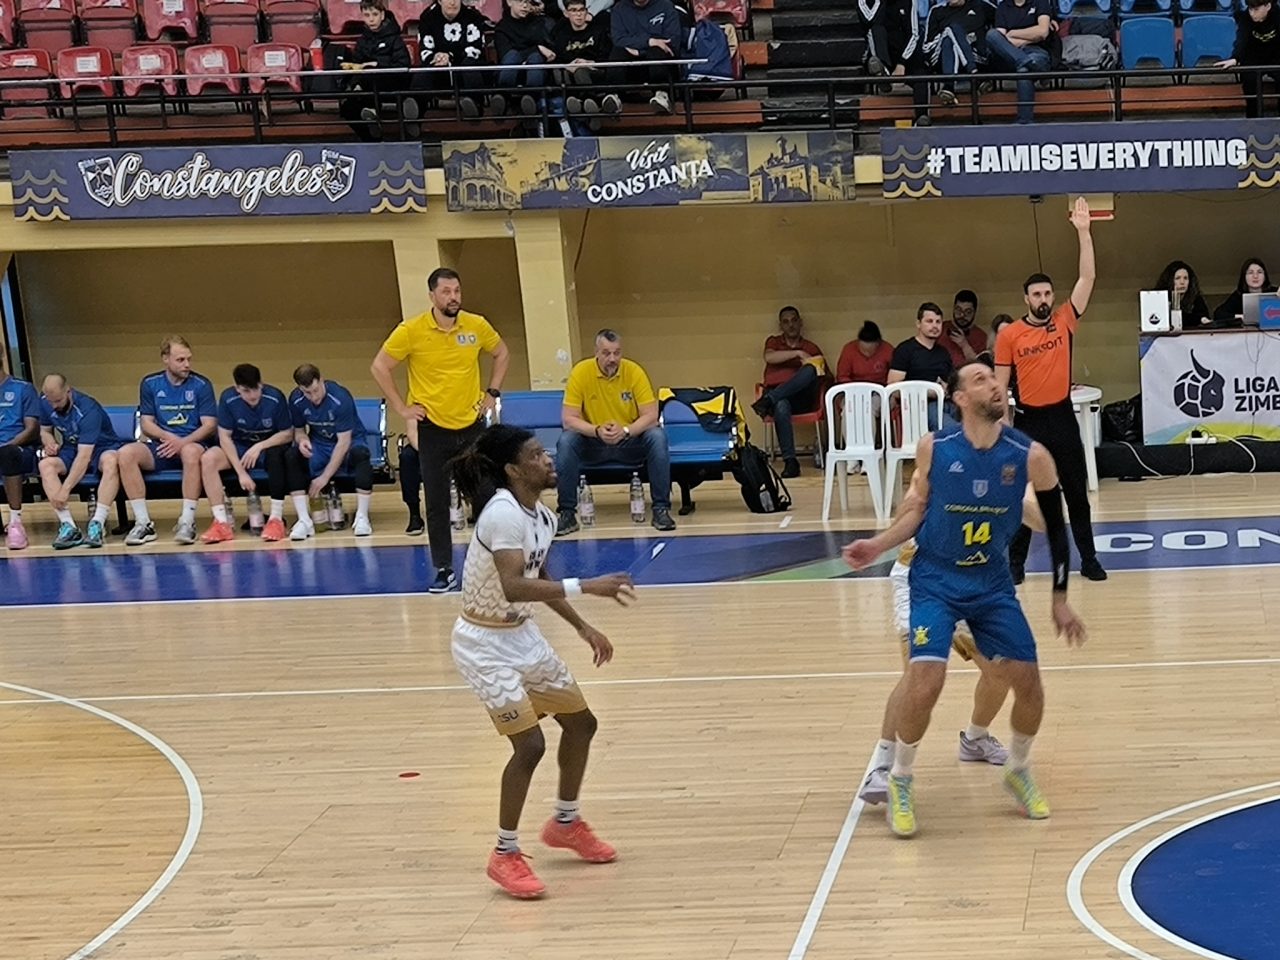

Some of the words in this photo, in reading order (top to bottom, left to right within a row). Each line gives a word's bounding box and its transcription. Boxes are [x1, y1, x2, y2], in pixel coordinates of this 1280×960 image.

[626, 140, 671, 171] Visit
[926, 138, 1248, 176] #TEAMISEVERYTHING
[113, 149, 329, 211] Constangeles
[1233, 375, 1280, 394] LIGA
[961, 520, 992, 547] 14
